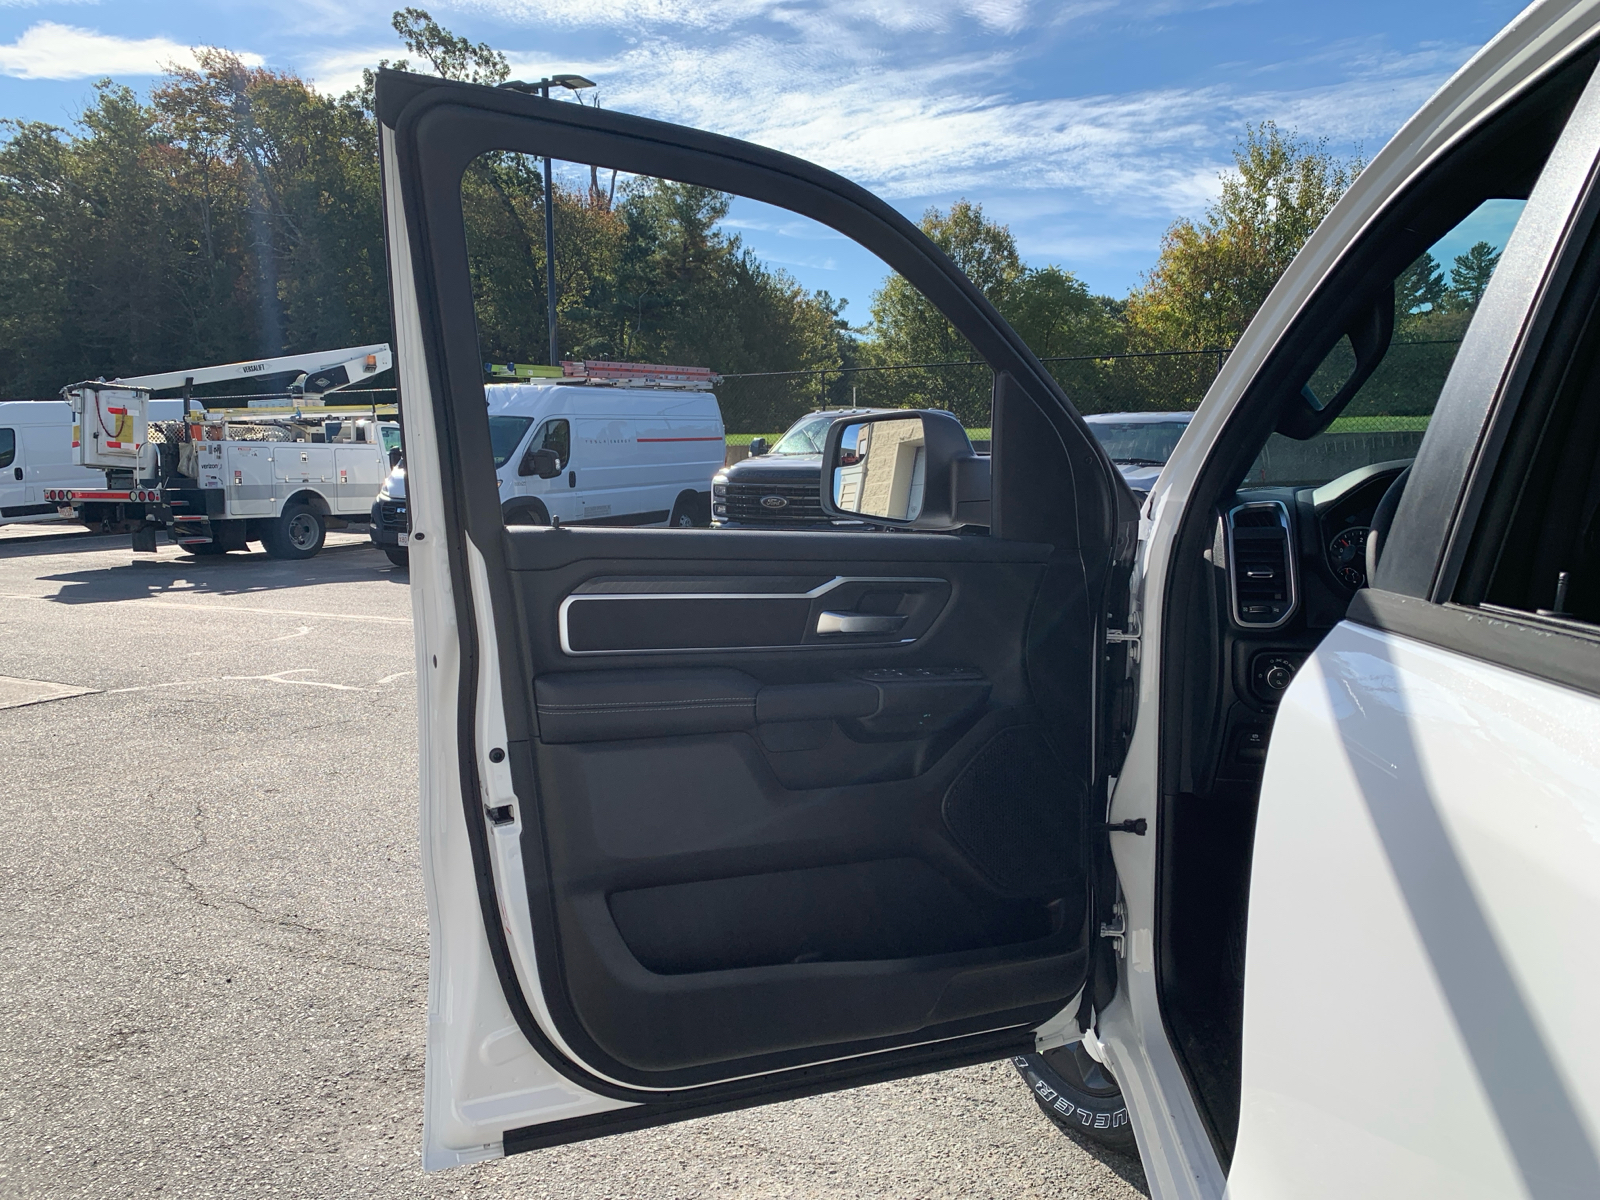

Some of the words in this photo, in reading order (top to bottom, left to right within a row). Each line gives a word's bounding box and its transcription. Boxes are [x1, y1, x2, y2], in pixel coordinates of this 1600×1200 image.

[242, 364, 265, 373] VERSALIFT
[766, 498, 780, 506] Ford
[1035, 1080, 1128, 1129] UELER
